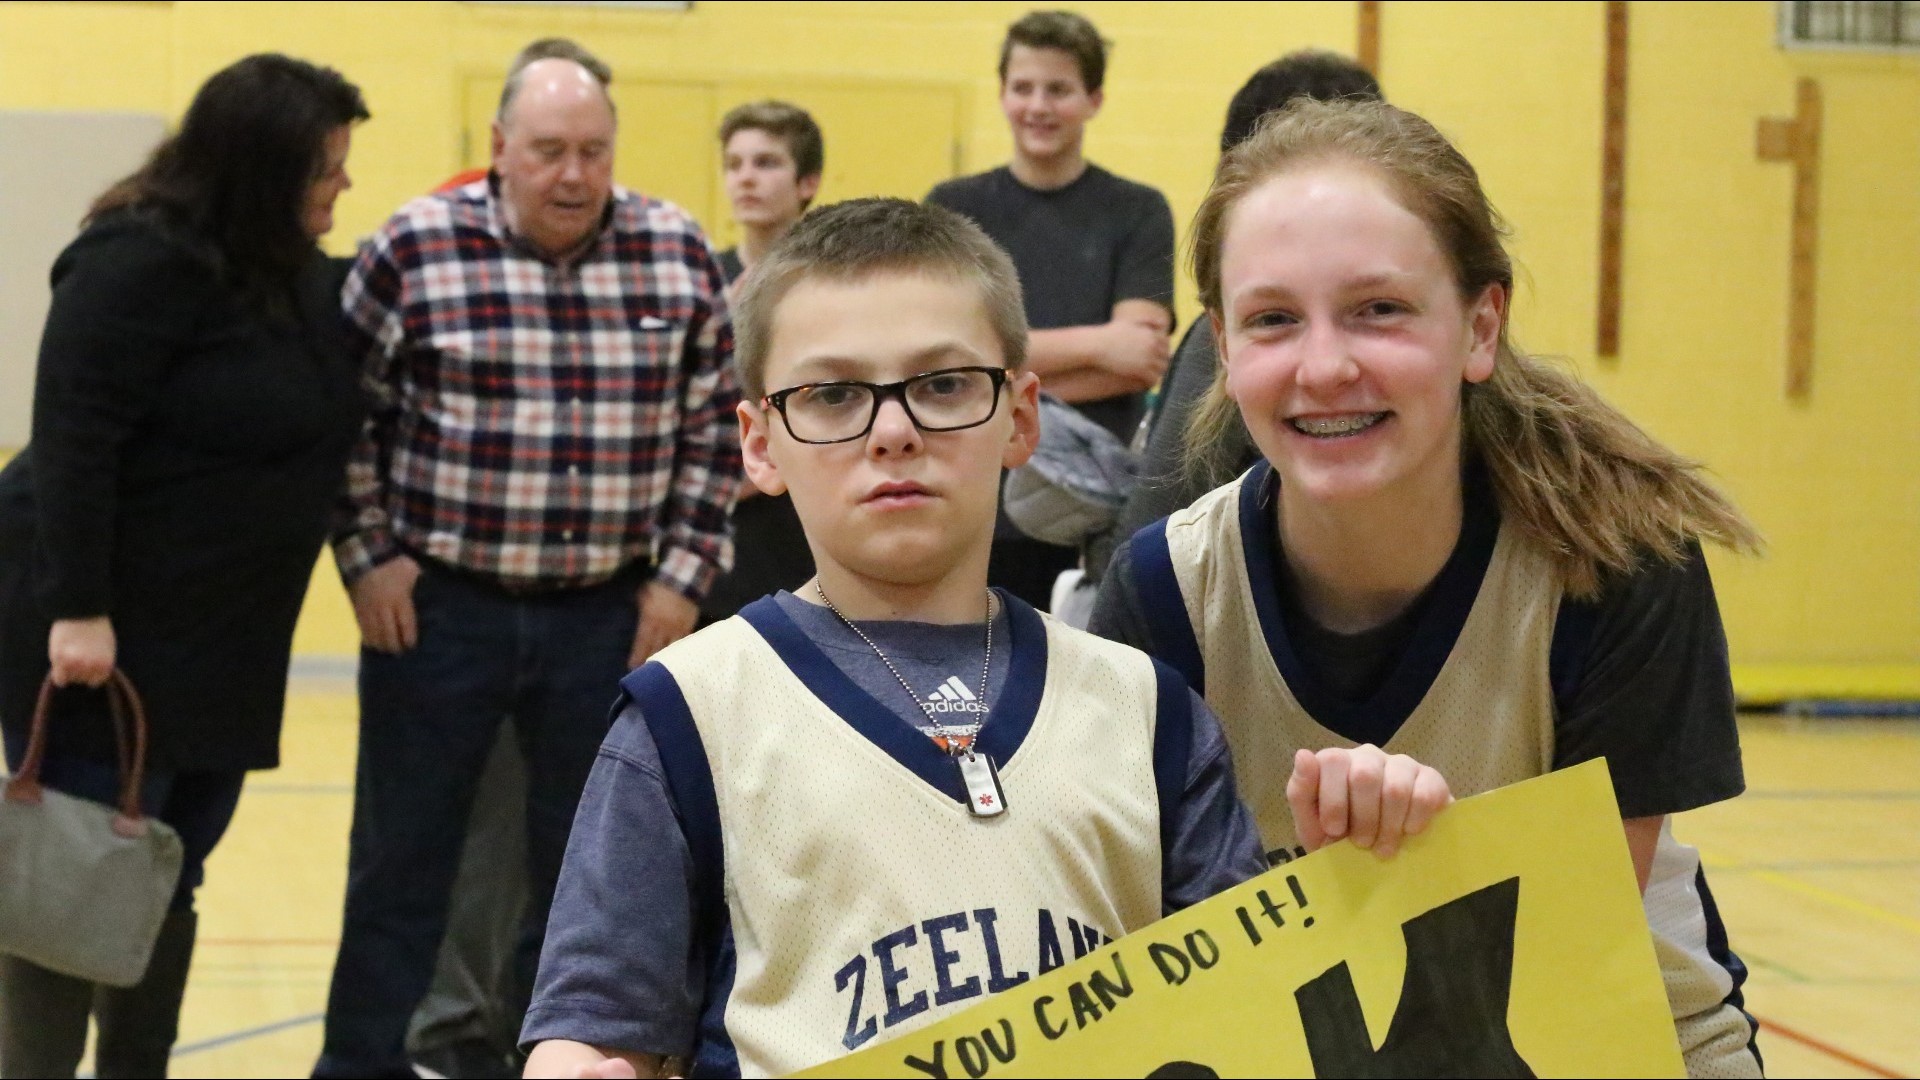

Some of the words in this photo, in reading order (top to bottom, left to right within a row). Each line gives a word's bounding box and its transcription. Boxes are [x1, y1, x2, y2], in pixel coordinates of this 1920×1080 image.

[923, 699, 990, 713] adidas
[834, 907, 1114, 1051] ZEELA
[903, 1018, 1016, 1079] YOU
[1033, 951, 1134, 1041] CAN
[1147, 928, 1220, 986] DO
